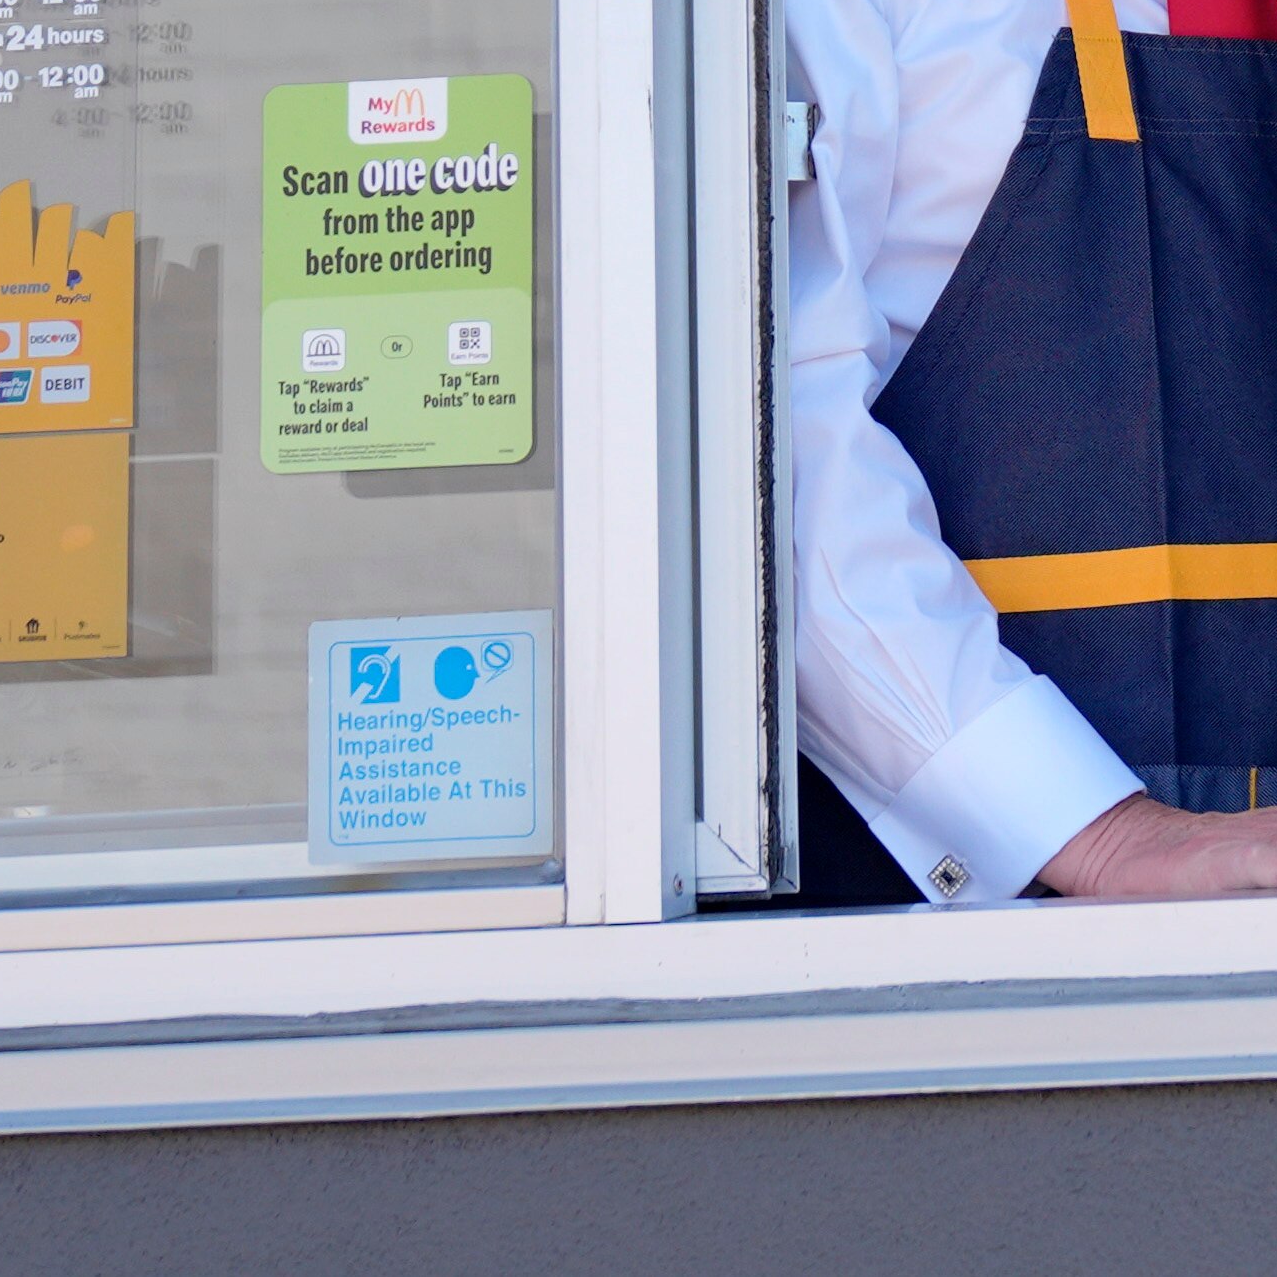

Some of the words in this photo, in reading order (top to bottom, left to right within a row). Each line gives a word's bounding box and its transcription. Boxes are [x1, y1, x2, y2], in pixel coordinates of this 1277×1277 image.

[73, 3, 98, 16] am
[6, 25, 44, 51] 24
[47, 26, 105, 45] hours
[38, 64, 104, 88] 12:00
[74, 86, 99, 99] am
[367, 96, 393, 113] My
[361, 117, 435, 135] Rewards
[282, 165, 349, 197] Scan
[359, 157, 426, 198] one
[431, 142, 519, 194] code
[323, 208, 378, 236] from
[385, 205, 424, 233] the
[431, 208, 475, 238] app
[306, 247, 383, 276] before
[390, 241, 492, 274] ordering
[0, 283, 51, 295] venmo
[55, 293, 92, 305] PayPal
[30, 333, 77, 345] DISCOVER
[391, 341, 403, 353] Or
[45, 377, 85, 391] DEBIT
[278, 381, 300, 399] Tap
[439, 373, 462, 391] Tap
[293, 401, 306, 415] to
[309, 398, 343, 414] claim
[346, 401, 354, 413] a
[472, 392, 485, 406] to
[488, 394, 516, 406] earn
[279, 419, 322, 436] reward
[325, 421, 339, 434] or
[342, 418, 368, 433] deal
[338, 704, 521, 732] Hearing/Speech-
[338, 734, 434, 759] Impaired
[338, 760, 462, 781] Assistance
[338, 782, 441, 806] Available
[448, 780, 472, 801] At
[480, 778, 527, 798] This
[338, 809, 427, 830] Window
